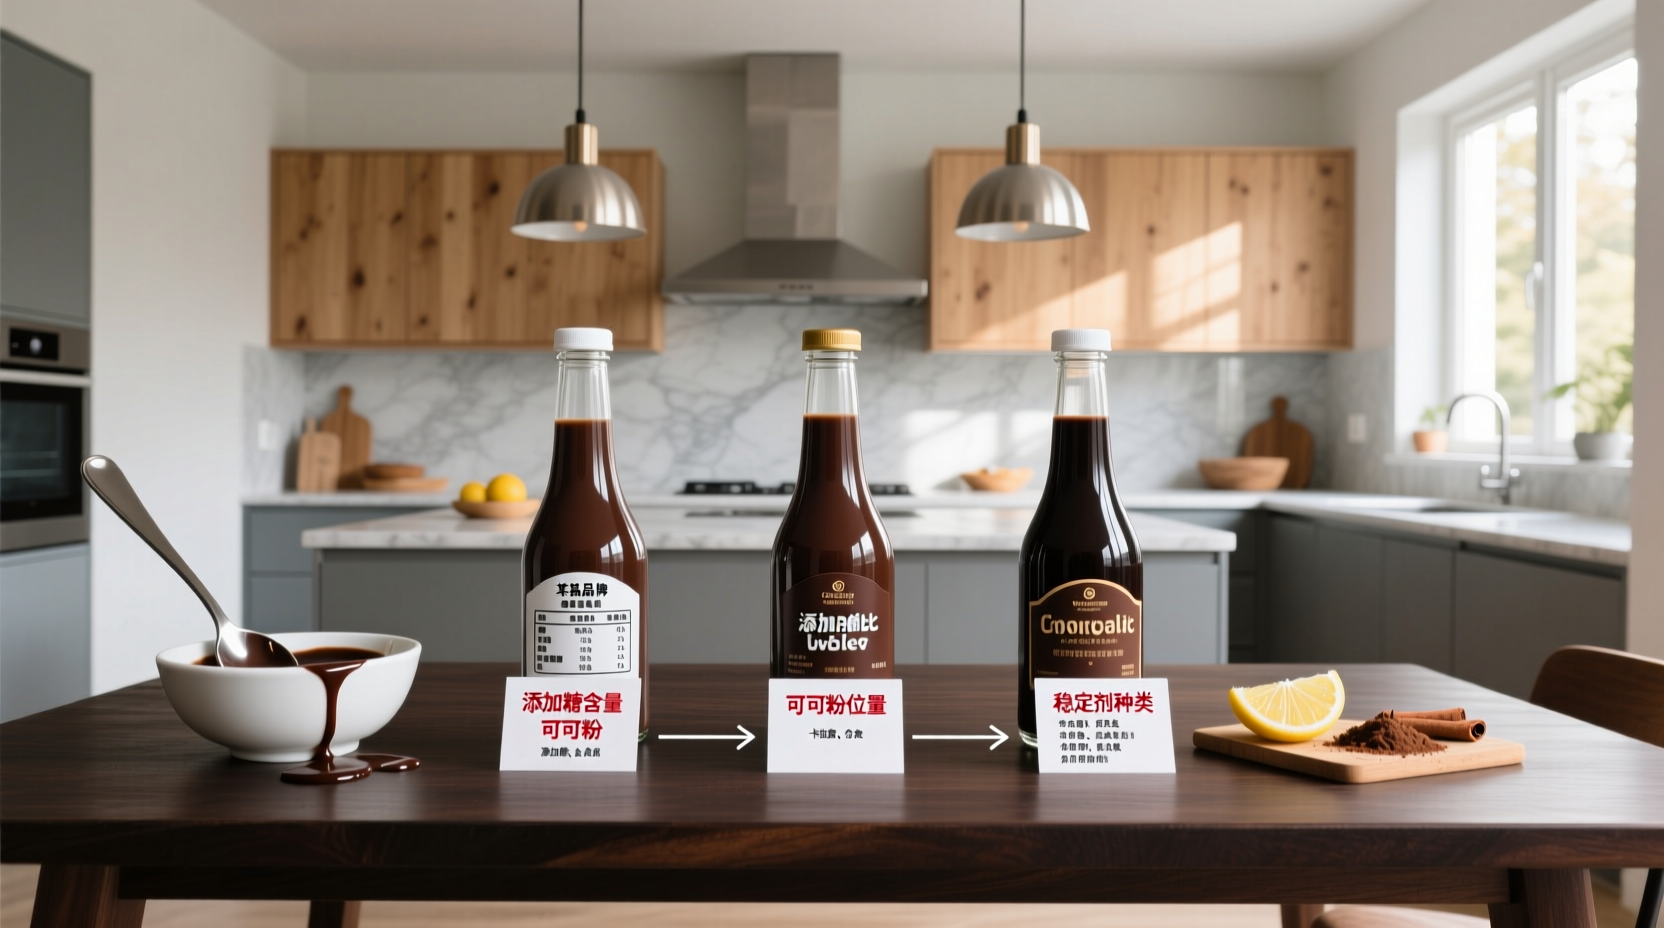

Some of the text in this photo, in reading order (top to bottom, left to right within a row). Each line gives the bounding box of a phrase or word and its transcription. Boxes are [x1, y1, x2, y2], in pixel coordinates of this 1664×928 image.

[522, 691, 623, 713] 添加糖含量
[1052, 691, 1154, 713] 稳定剂种类
[541, 718, 603, 740] 可可粉
